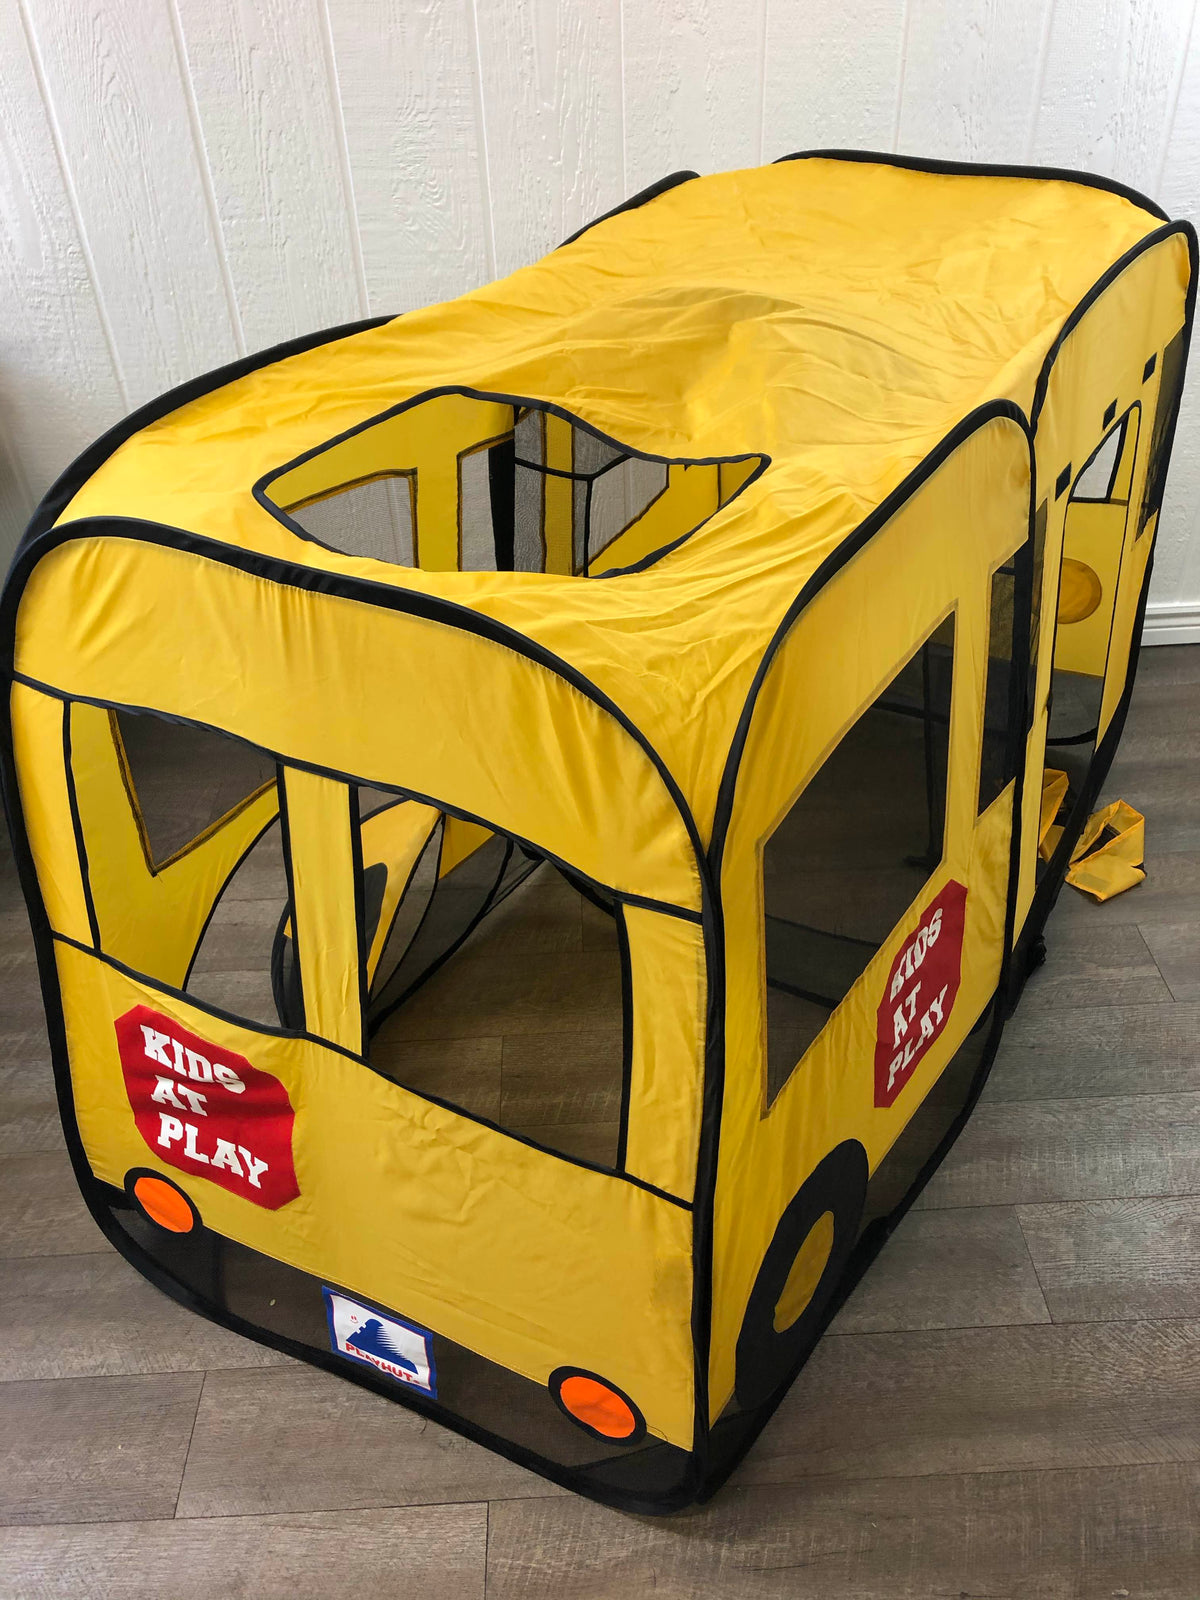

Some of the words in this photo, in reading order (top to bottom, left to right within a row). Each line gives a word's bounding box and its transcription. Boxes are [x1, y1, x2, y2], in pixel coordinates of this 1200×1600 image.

[889, 907, 943, 1003] KIDS
[886, 983, 948, 1093] PLAY
[892, 980, 922, 1050] AT
[140, 1024, 246, 1094] KIDS
[151, 1074, 208, 1117] AT
[157, 1111, 269, 1189] PLAY
